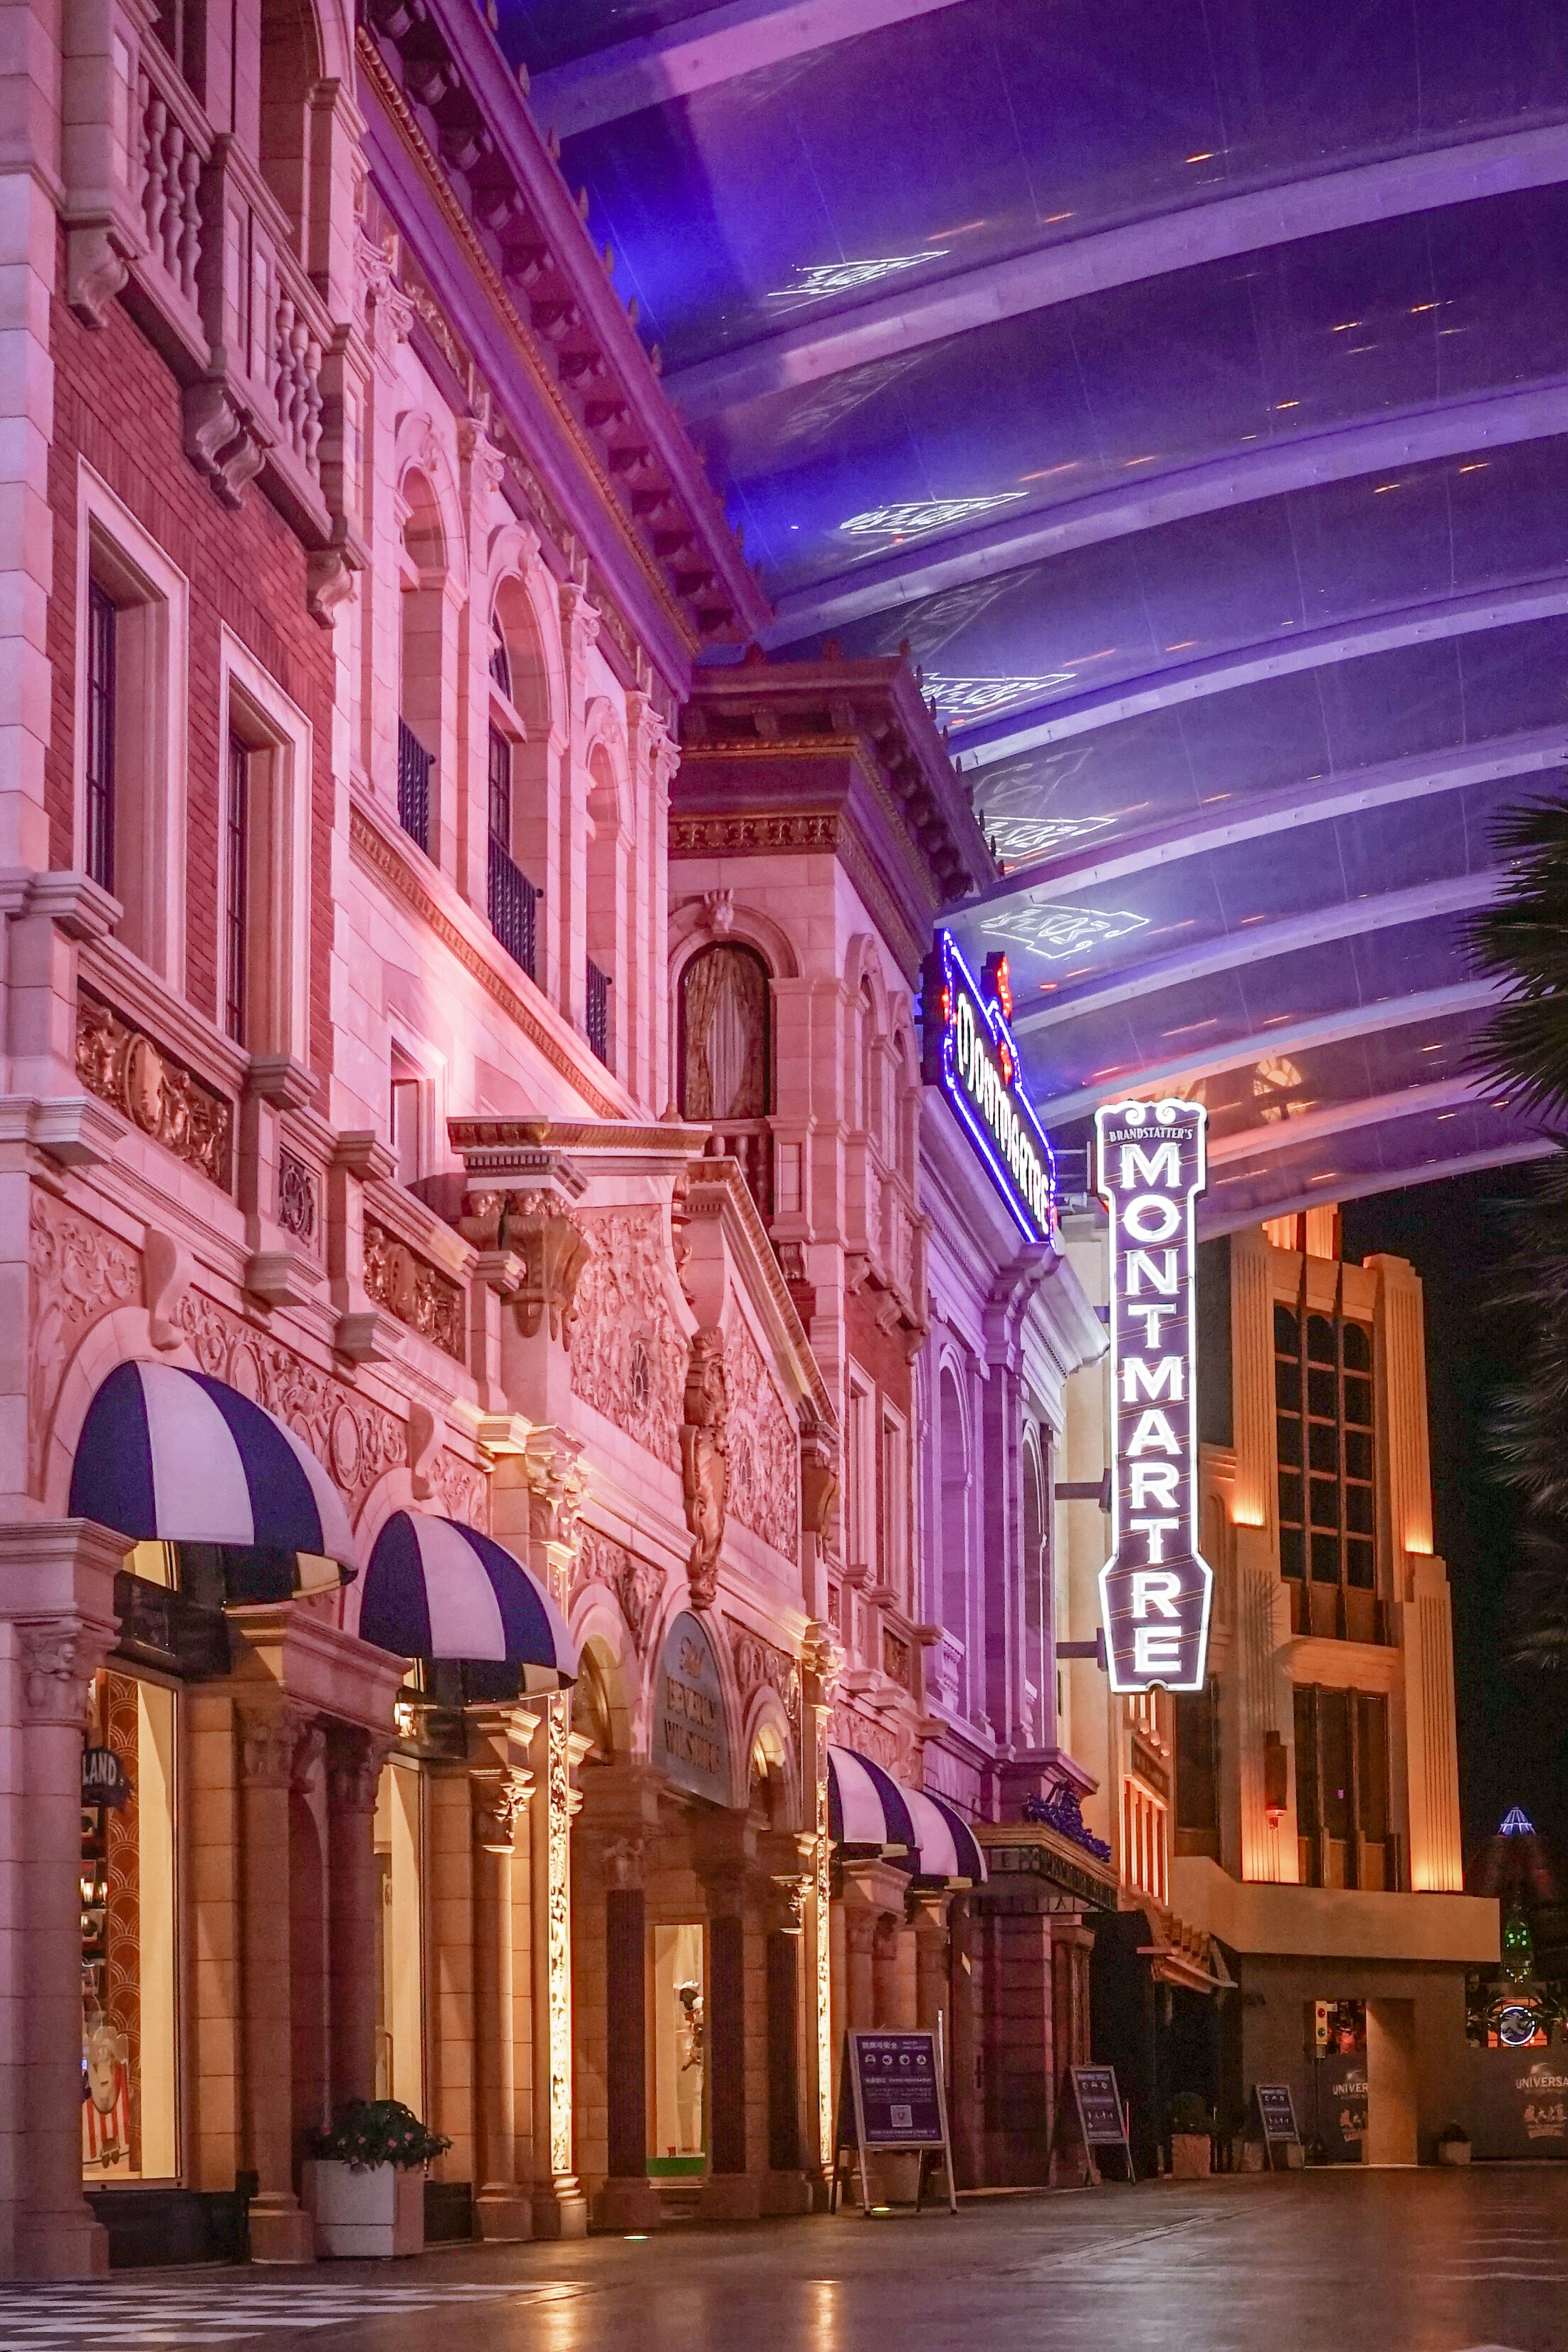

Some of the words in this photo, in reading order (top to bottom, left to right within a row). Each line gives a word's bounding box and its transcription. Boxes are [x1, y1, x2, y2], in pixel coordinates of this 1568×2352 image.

[957, 992, 1049, 1234] MONTMARTRE
[1108, 1127, 1194, 1142] BRANDSTATTER'S
[1119, 1142, 1185, 1672] MONTMARTRE
